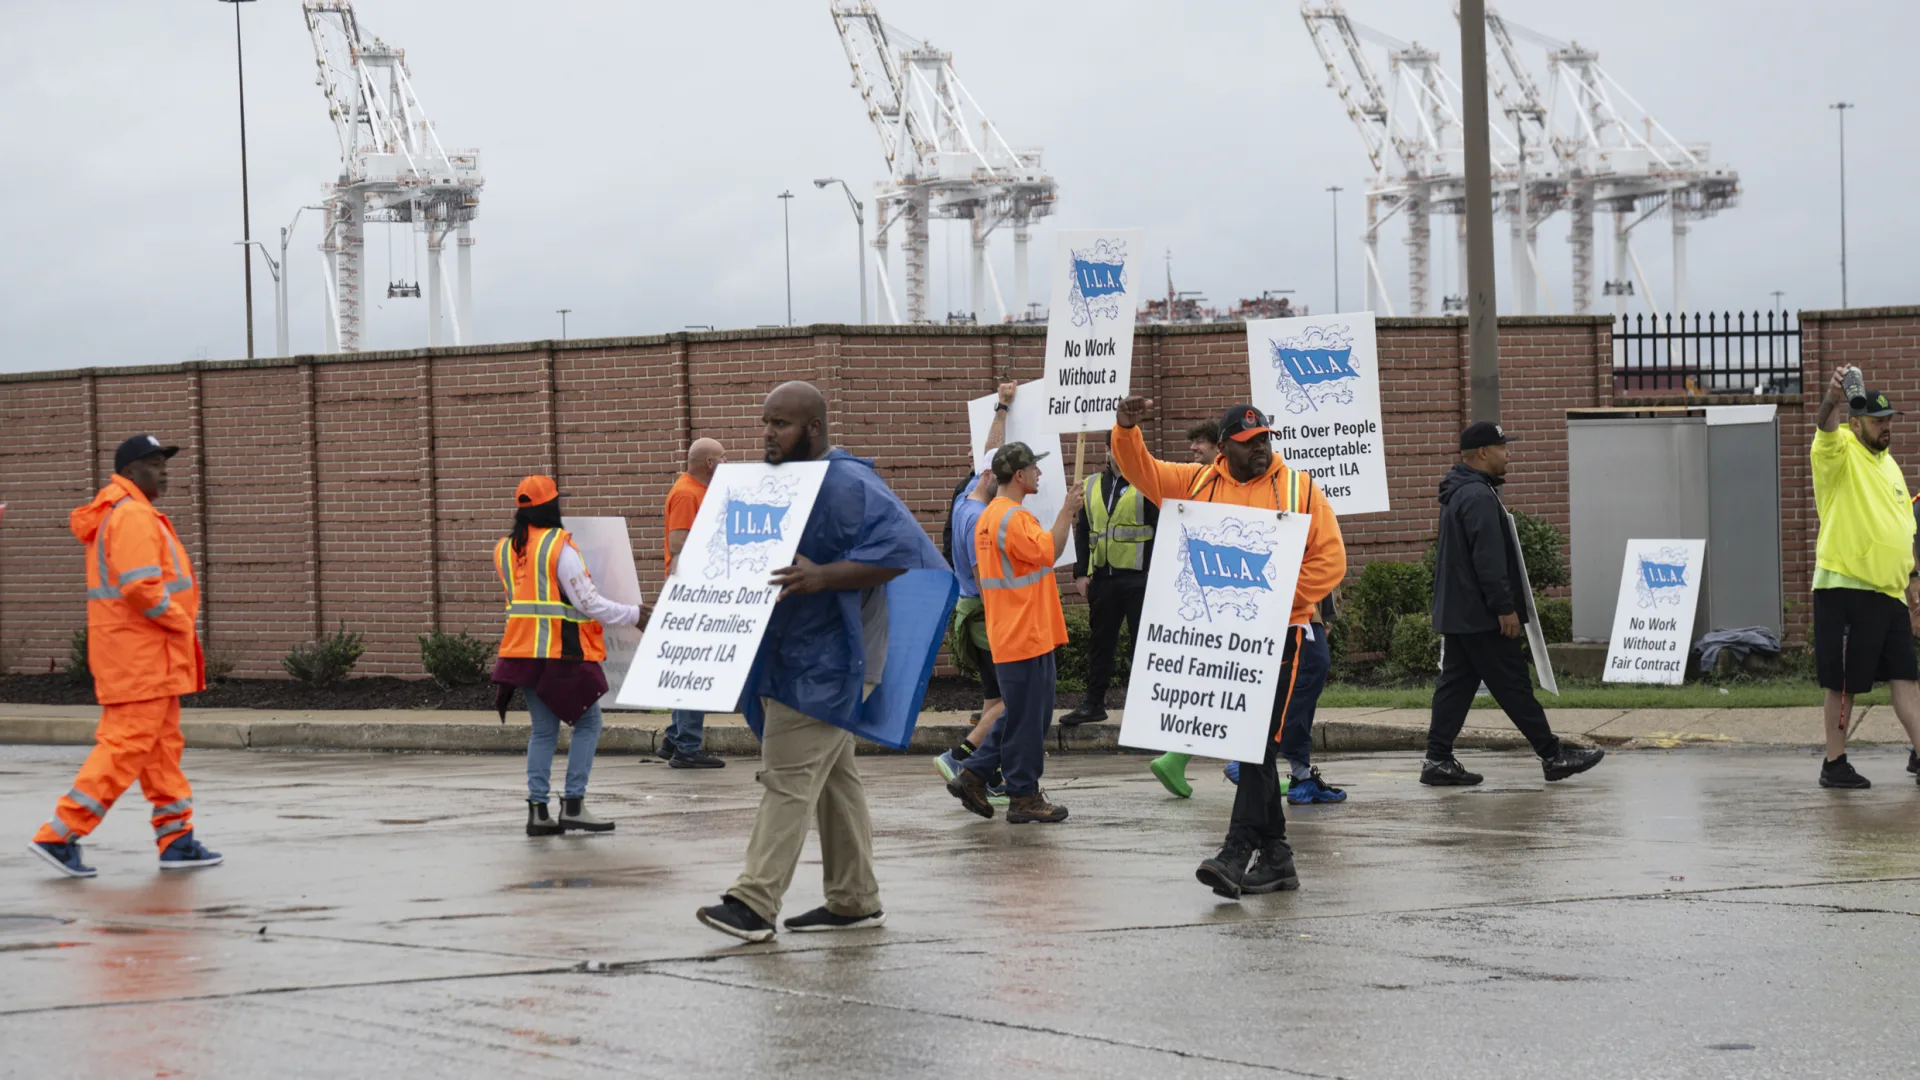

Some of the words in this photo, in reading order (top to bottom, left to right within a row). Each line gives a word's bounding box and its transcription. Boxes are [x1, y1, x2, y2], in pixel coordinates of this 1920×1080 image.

[1082, 269, 1119, 289] I.L.A.
[1064, 340, 1081, 358] No
[1085, 337, 1116, 357] Work
[1291, 356, 1348, 376] I.L.A.
[1059, 367, 1106, 387] Without
[1109, 369, 1117, 384] a
[1048, 396, 1071, 416] Fair
[1270, 426, 1297, 441] rofit
[1300, 425, 1330, 439] Over
[1334, 420, 1377, 438] People
[1284, 441, 1372, 461] Unacceptable:
[1297, 464, 1336, 479] port
[1339, 462, 1360, 476] ILA
[1321, 484, 1351, 498] kers
[734, 510, 778, 535] I.L.A.
[1199, 550, 1261, 582] I.L.A.
[1648, 567, 1682, 583] I.L.A.
[668, 584, 734, 604] Machines
[735, 586, 772, 605] Don't
[660, 612, 694, 631] Feed
[695, 613, 757, 635] Families:
[1629, 617, 1645, 631] No
[1648, 617, 1677, 632] Work
[1147, 623, 1223, 650] Machines
[1228, 633, 1275, 656] Don't
[1623, 636, 1667, 651] Without
[1669, 641, 1677, 651] a
[657, 640, 713, 666] Support
[714, 644, 737, 663] ILA
[1147, 653, 1185, 675] Feed
[1188, 657, 1264, 685] Families:
[1611, 656, 1632, 669] Fair
[1634, 657, 1681, 672] Contract
[658, 670, 715, 691] Workers
[1151, 682, 1215, 710] Support
[1220, 691, 1247, 713] ILA
[1160, 712, 1228, 740] Workers
